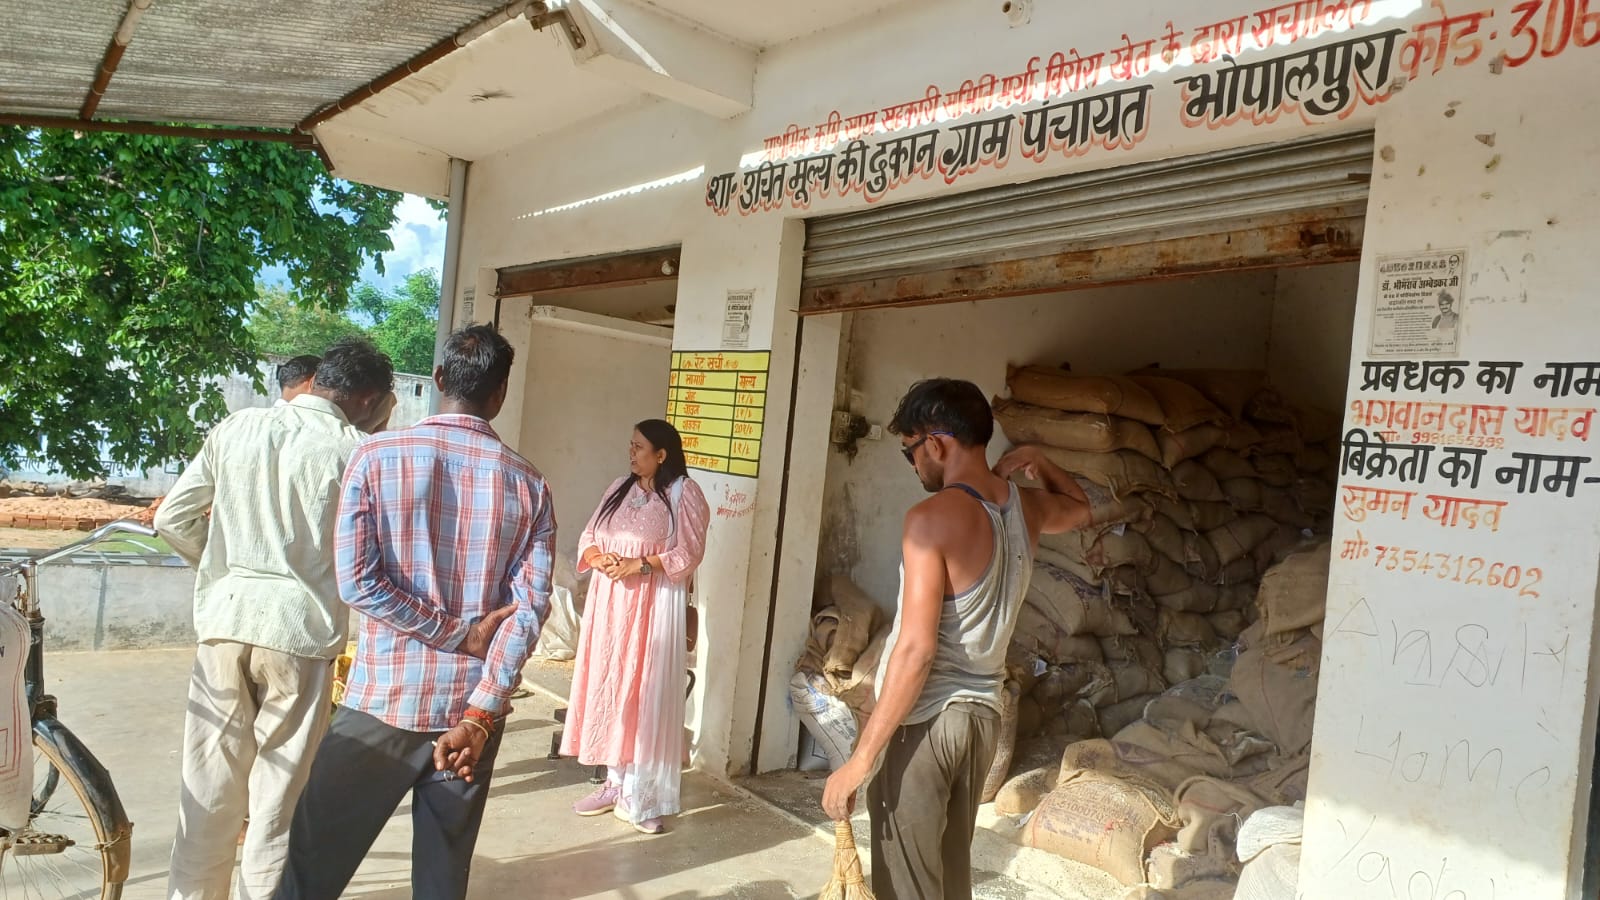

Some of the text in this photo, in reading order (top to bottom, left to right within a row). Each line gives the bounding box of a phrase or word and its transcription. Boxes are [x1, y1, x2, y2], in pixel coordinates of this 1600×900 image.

[1110, 34, 1157, 80] खेत
[1161, 21, 1184, 65] के
[1190, 16, 1249, 63] द्वारा
[739, 161, 788, 210] उचित
[789, 153, 836, 203] मूल्य
[837, 140, 870, 189] की
[866, 129, 940, 194] दुकान
[942, 114, 1016, 176] ग्राम
[1022, 84, 1154, 154] पंचायत
[1173, 28, 1407, 122] भोपालपुरा
[1393, 279, 1417, 291] भीमराव
[1360, 361, 1600, 399] प्रबधक का नाम
[1514, 405, 1598, 442] यादव
[1340, 428, 1436, 484] बिक्रेता
[1438, 446, 1488, 489] का
[1341, 485, 1509, 532] सुमन यादव
[1374, 545, 1544, 599] 7354312602
